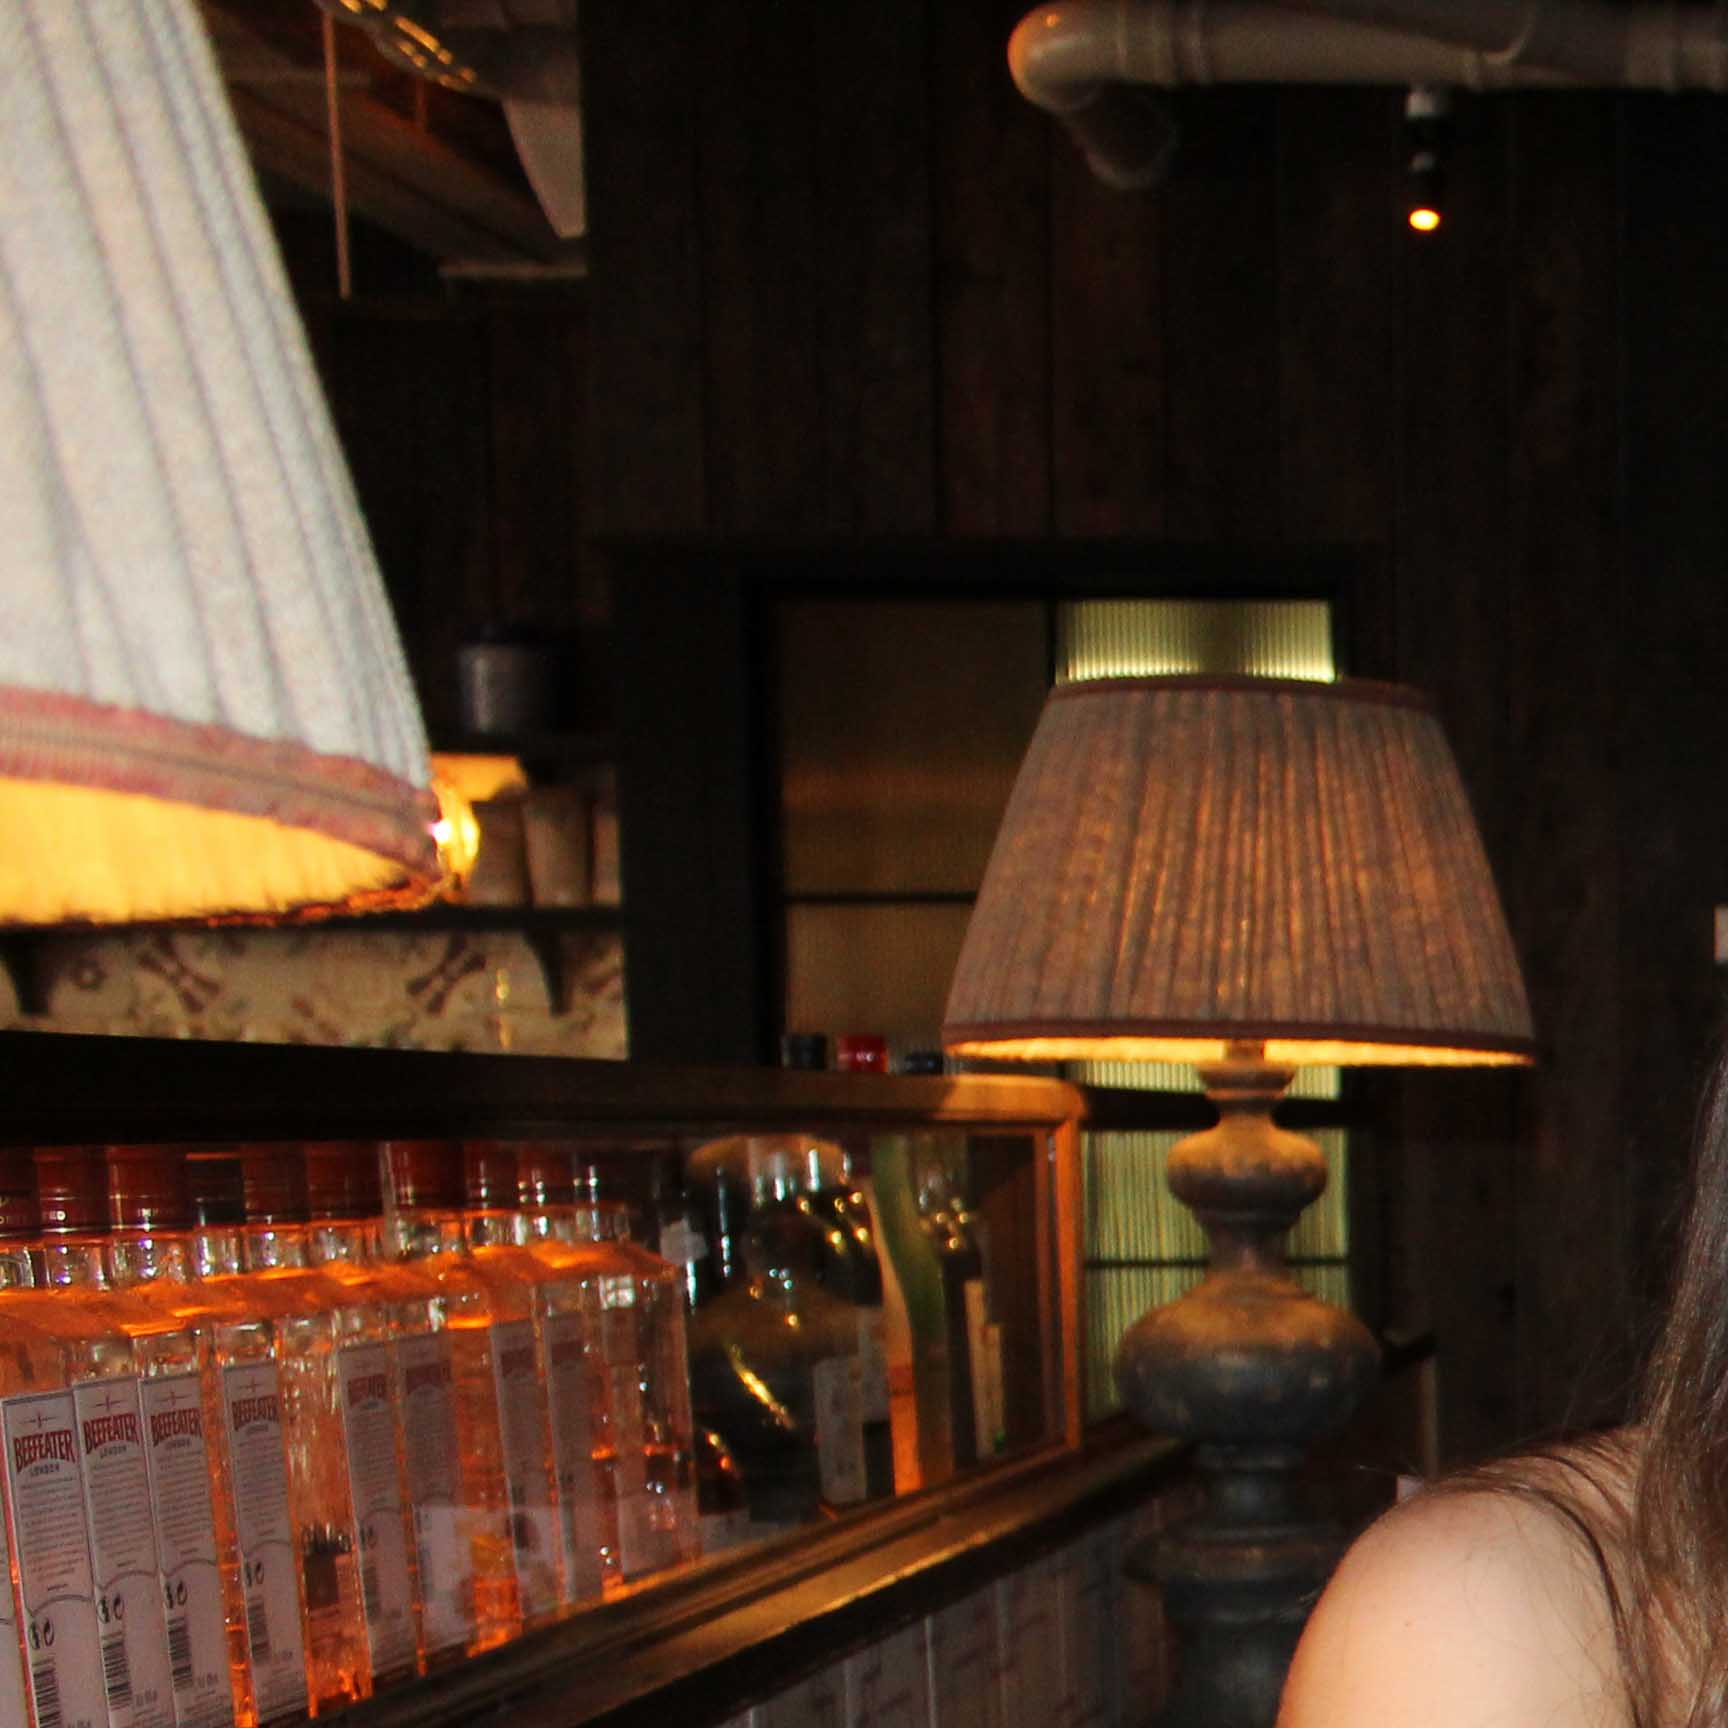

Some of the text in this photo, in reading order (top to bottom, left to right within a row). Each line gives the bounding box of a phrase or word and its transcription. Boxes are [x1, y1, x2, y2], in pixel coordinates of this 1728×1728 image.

[83, 1412, 140, 1454] BEEFEATER
[151, 1408, 202, 1446] BEEFEATER
[13, 1429, 76, 1473] BEEFEATER
